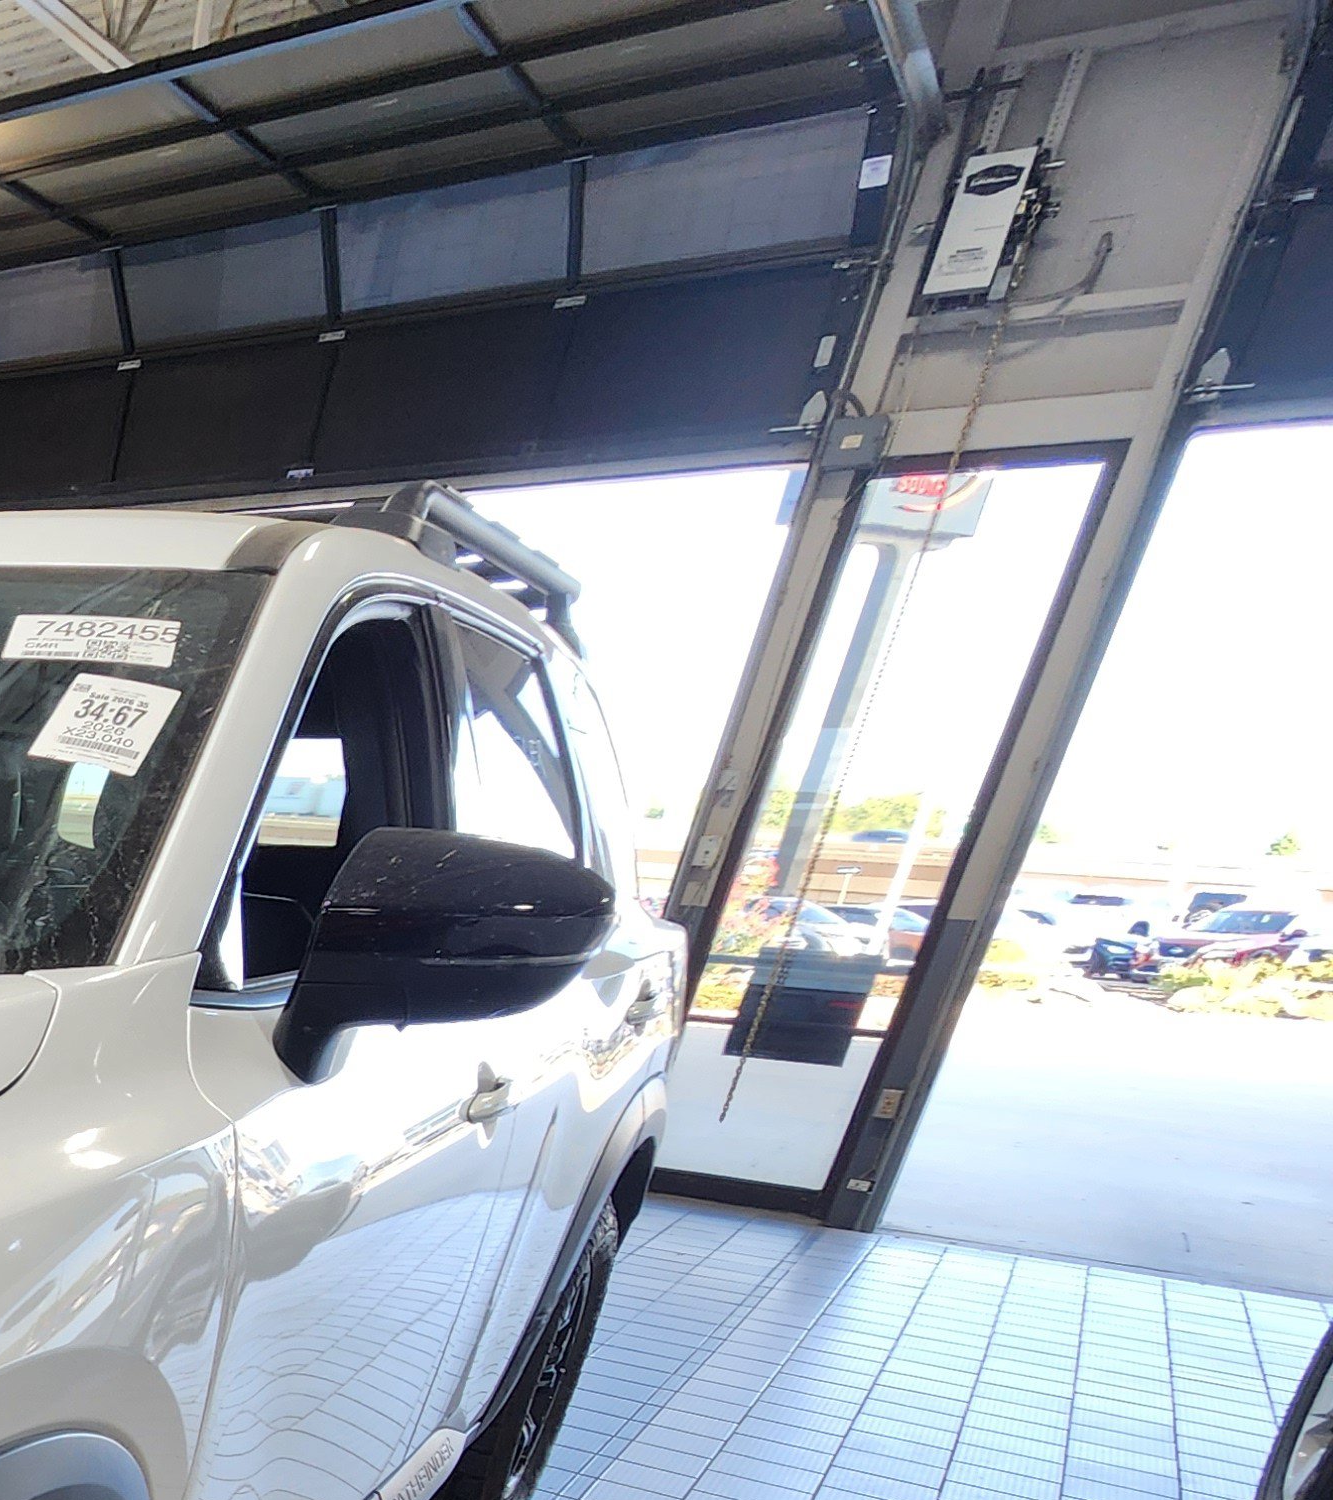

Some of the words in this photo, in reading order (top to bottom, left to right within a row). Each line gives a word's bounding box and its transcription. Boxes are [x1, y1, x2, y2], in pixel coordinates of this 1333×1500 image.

[36, 620, 181, 643] 7482455
[88, 692, 109, 701] Sale
[74, 699, 148, 728] 34:67
[62, 726, 134, 748] X23,040
[82, 721, 126, 737] 2026
